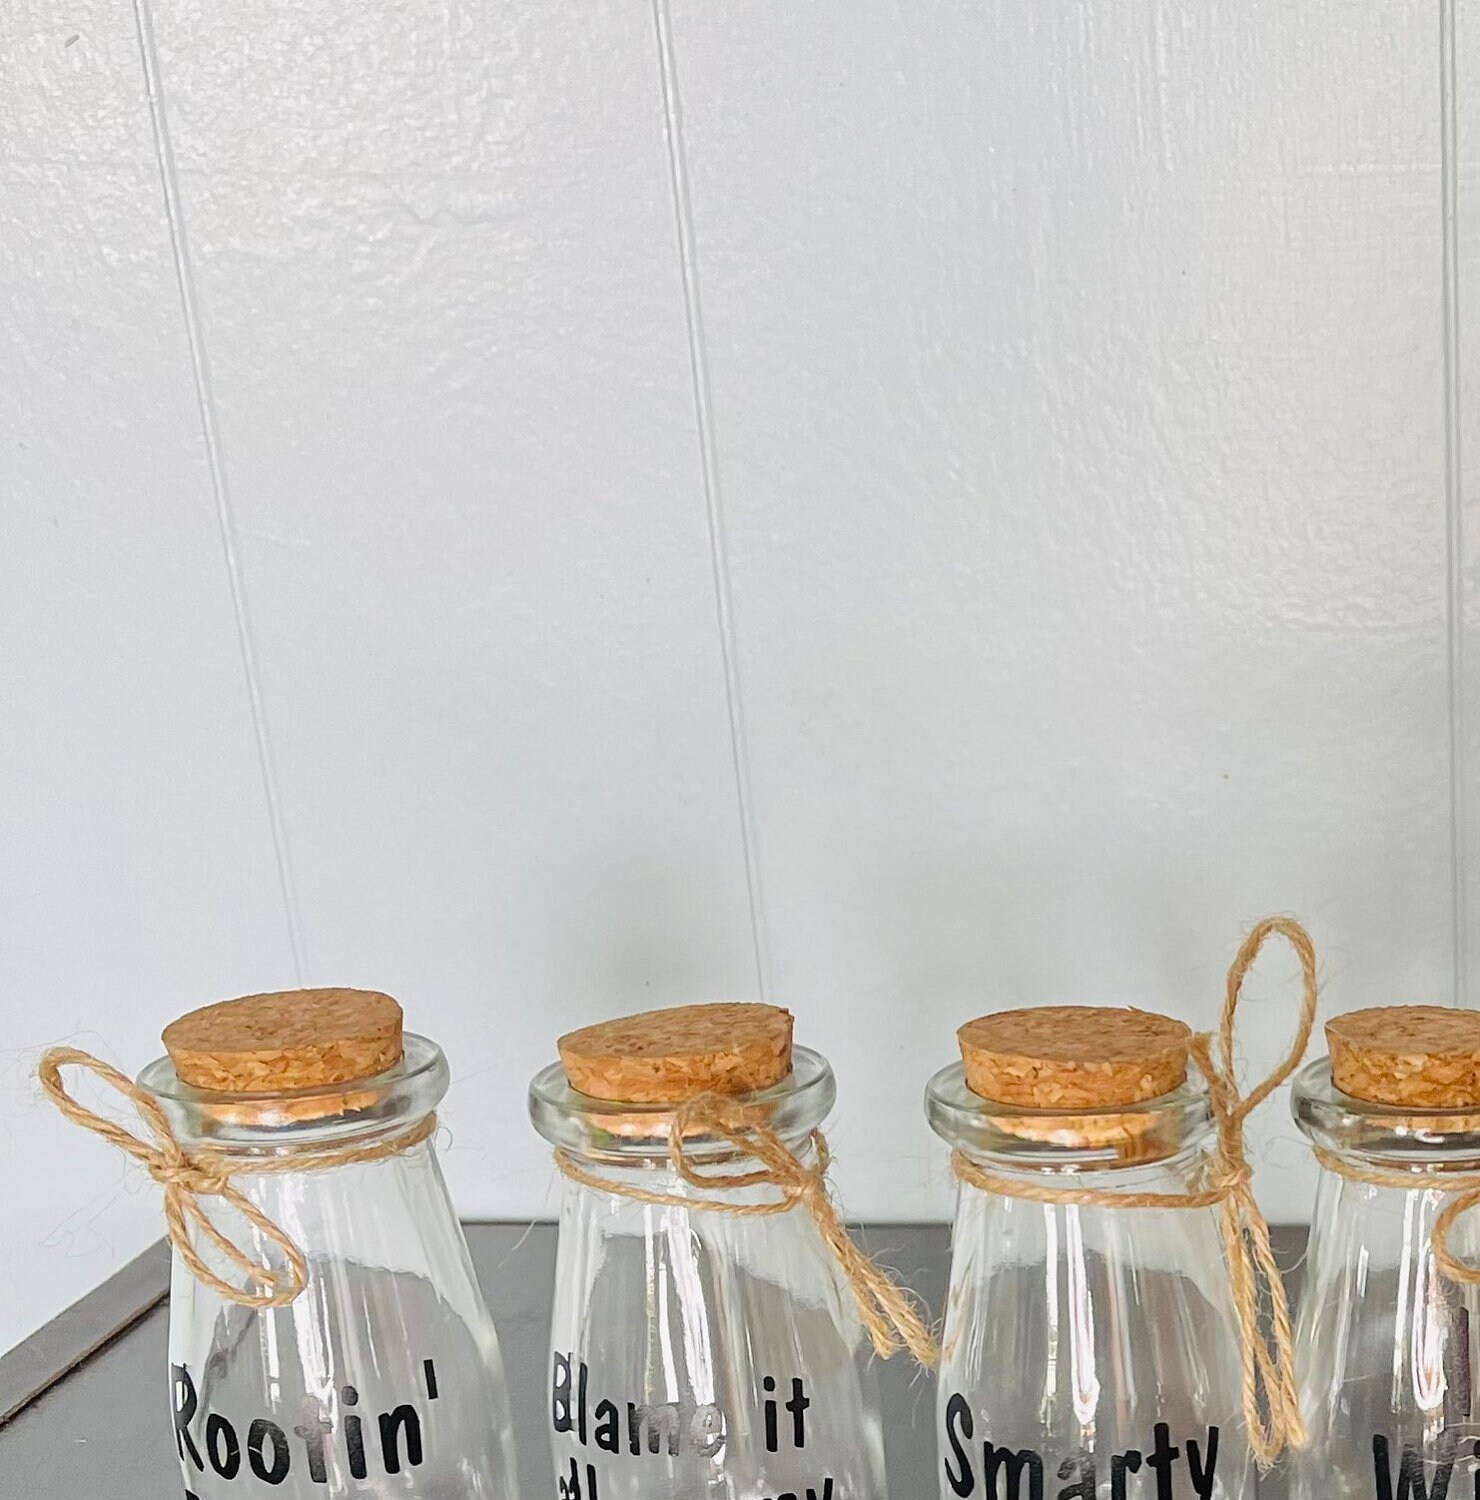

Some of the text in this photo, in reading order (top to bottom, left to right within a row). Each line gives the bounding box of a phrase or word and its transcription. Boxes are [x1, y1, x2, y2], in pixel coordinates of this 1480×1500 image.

[171, 1359, 438, 1485] Rootin'
[553, 1351, 810, 1458] Blame it
